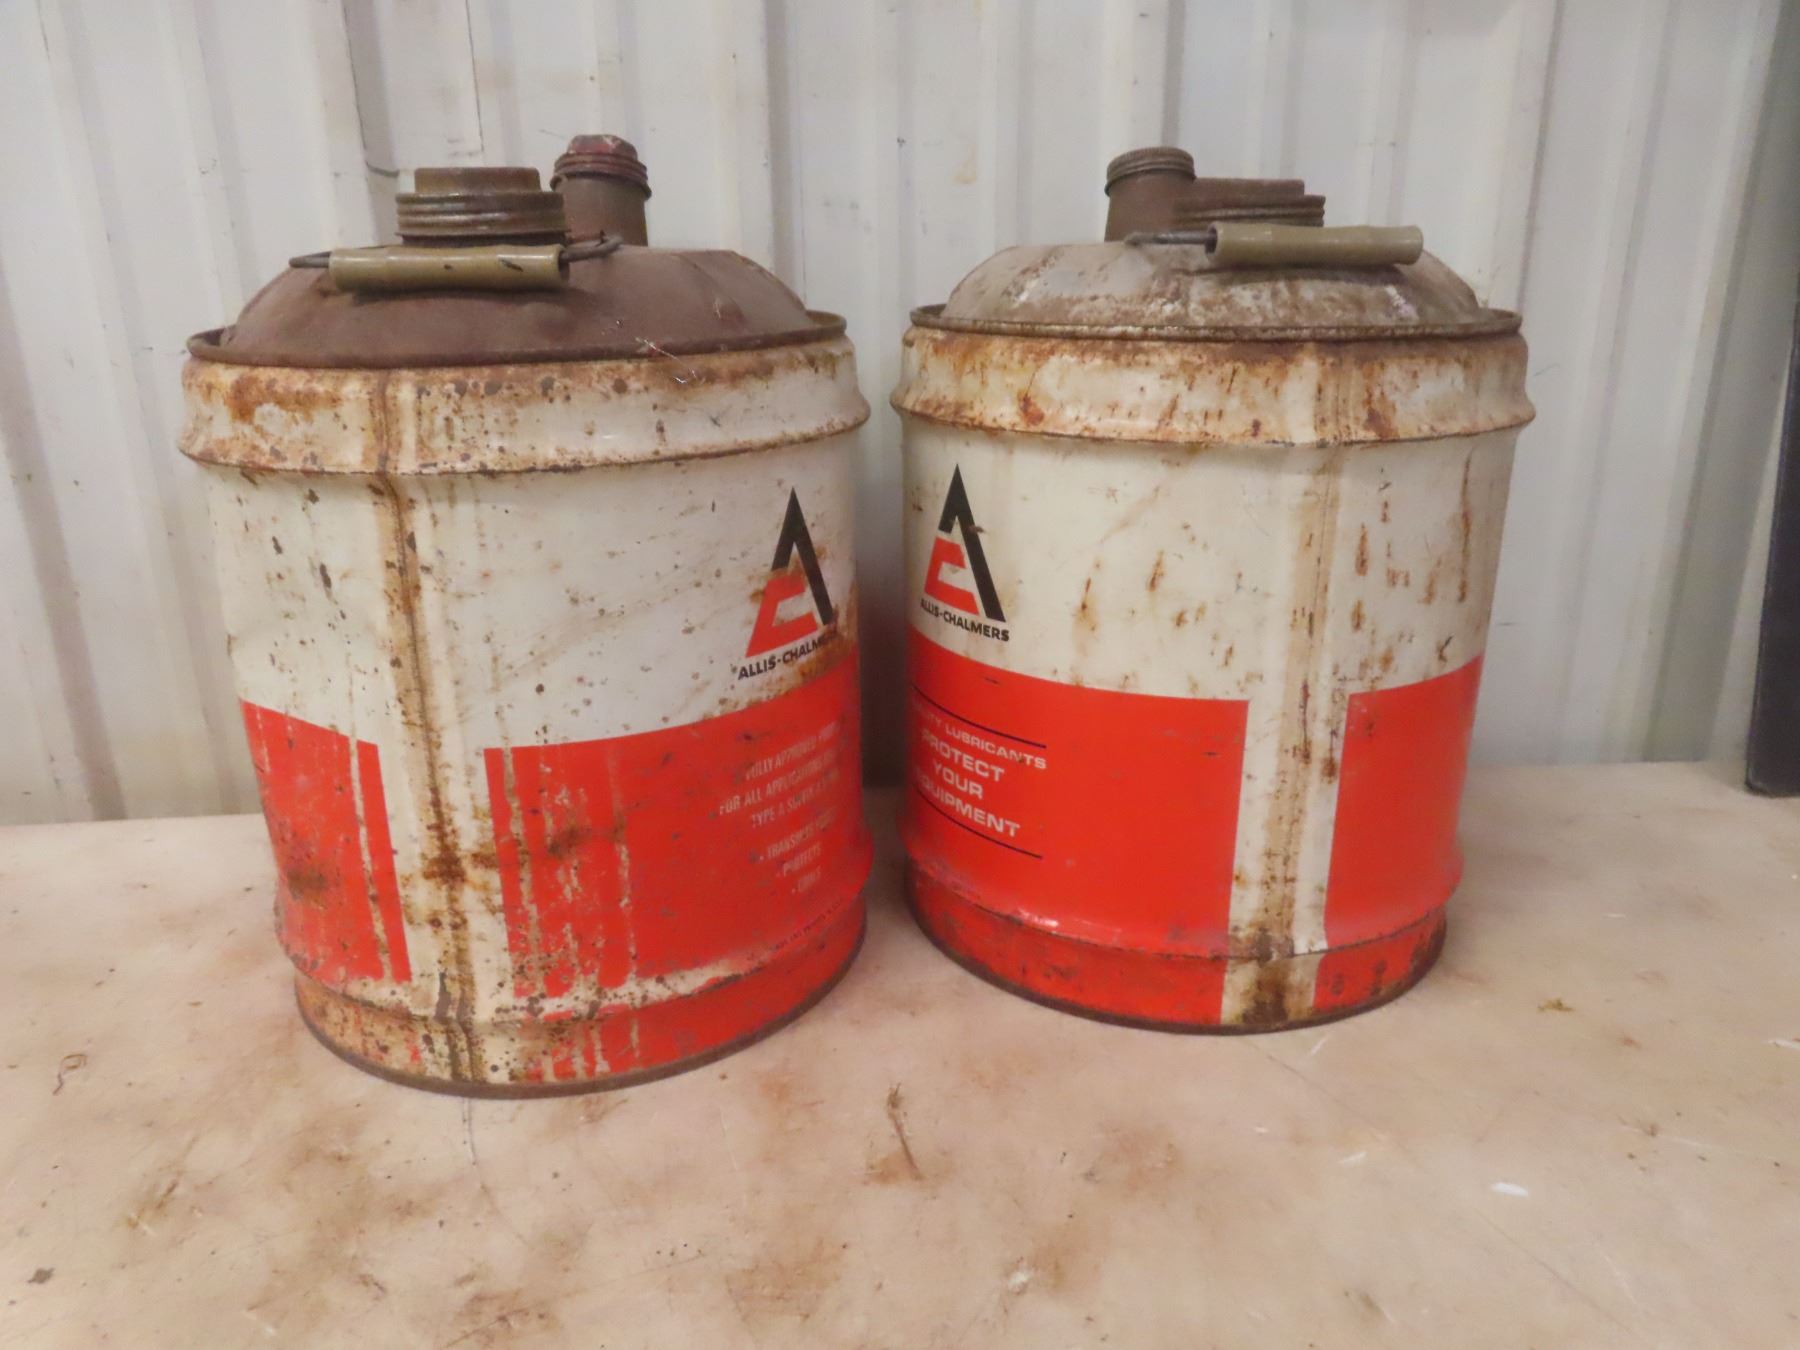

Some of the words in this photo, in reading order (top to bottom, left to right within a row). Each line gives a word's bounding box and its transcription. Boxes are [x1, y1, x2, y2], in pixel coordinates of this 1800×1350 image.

[920, 598, 1010, 642] ALLIS-CHALMERS
[738, 635, 830, 680] ALLIS-CHALM
[922, 728, 1005, 782] PROTECT
[945, 723, 1047, 770] LUBRICANTS
[932, 759, 984, 800] YOUR
